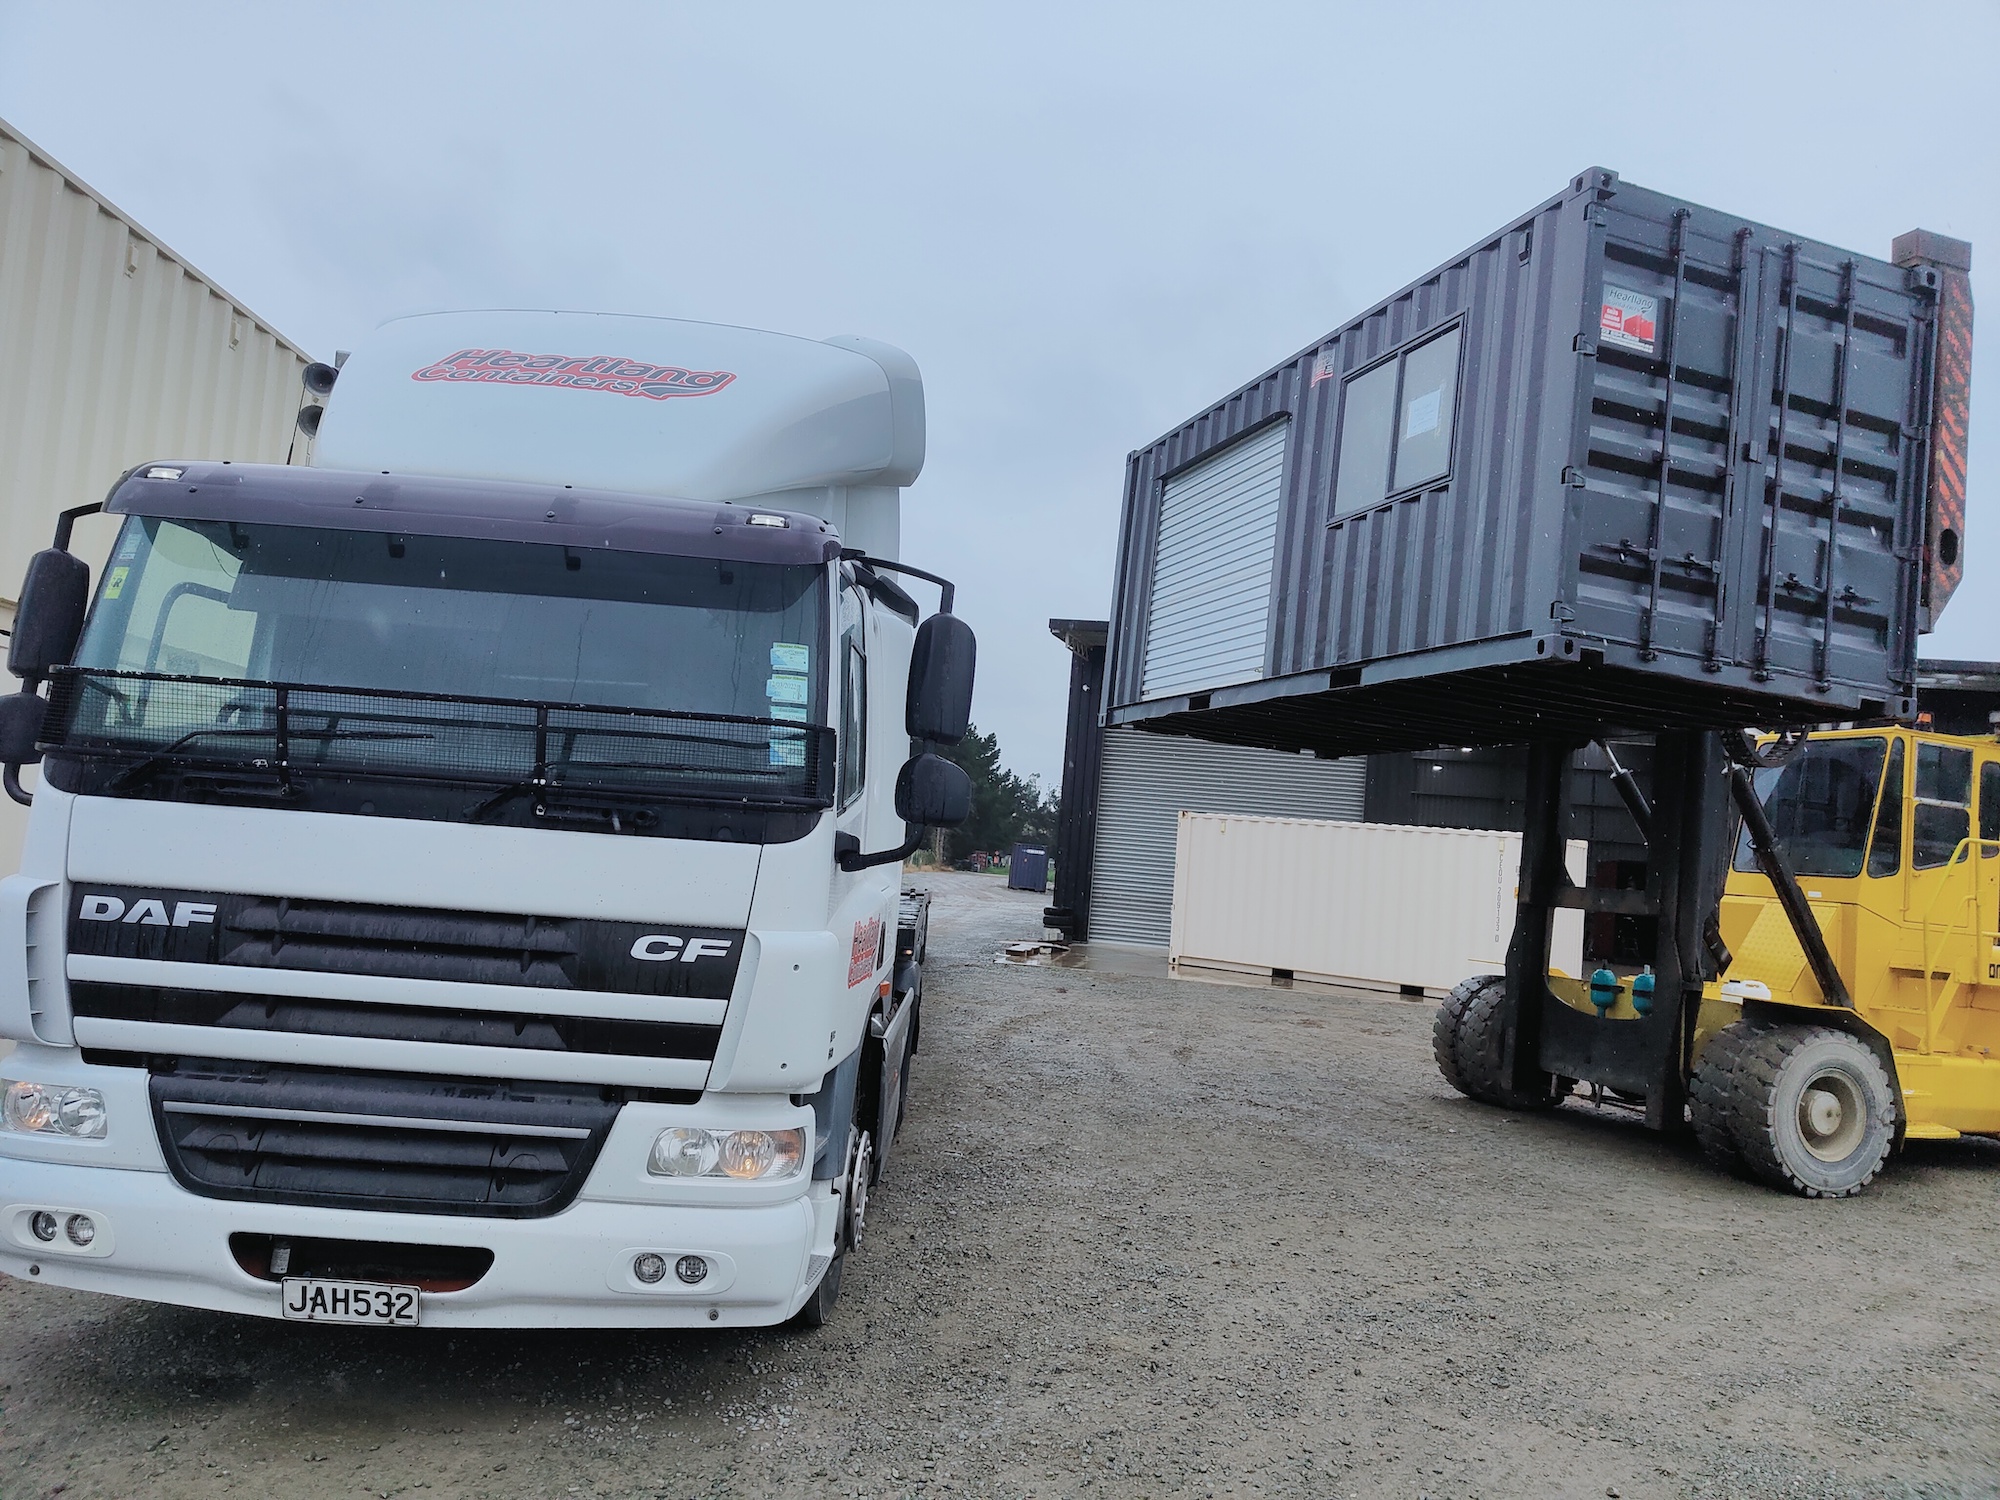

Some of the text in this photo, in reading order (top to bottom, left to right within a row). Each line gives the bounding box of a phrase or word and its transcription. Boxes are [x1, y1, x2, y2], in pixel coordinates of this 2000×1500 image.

[418, 365, 638, 391] Containers
[441, 350, 731, 388] Heartland
[79, 894, 218, 928] DAF
[629, 934, 732, 964] CF
[289, 1286, 413, 1320] JAH532
